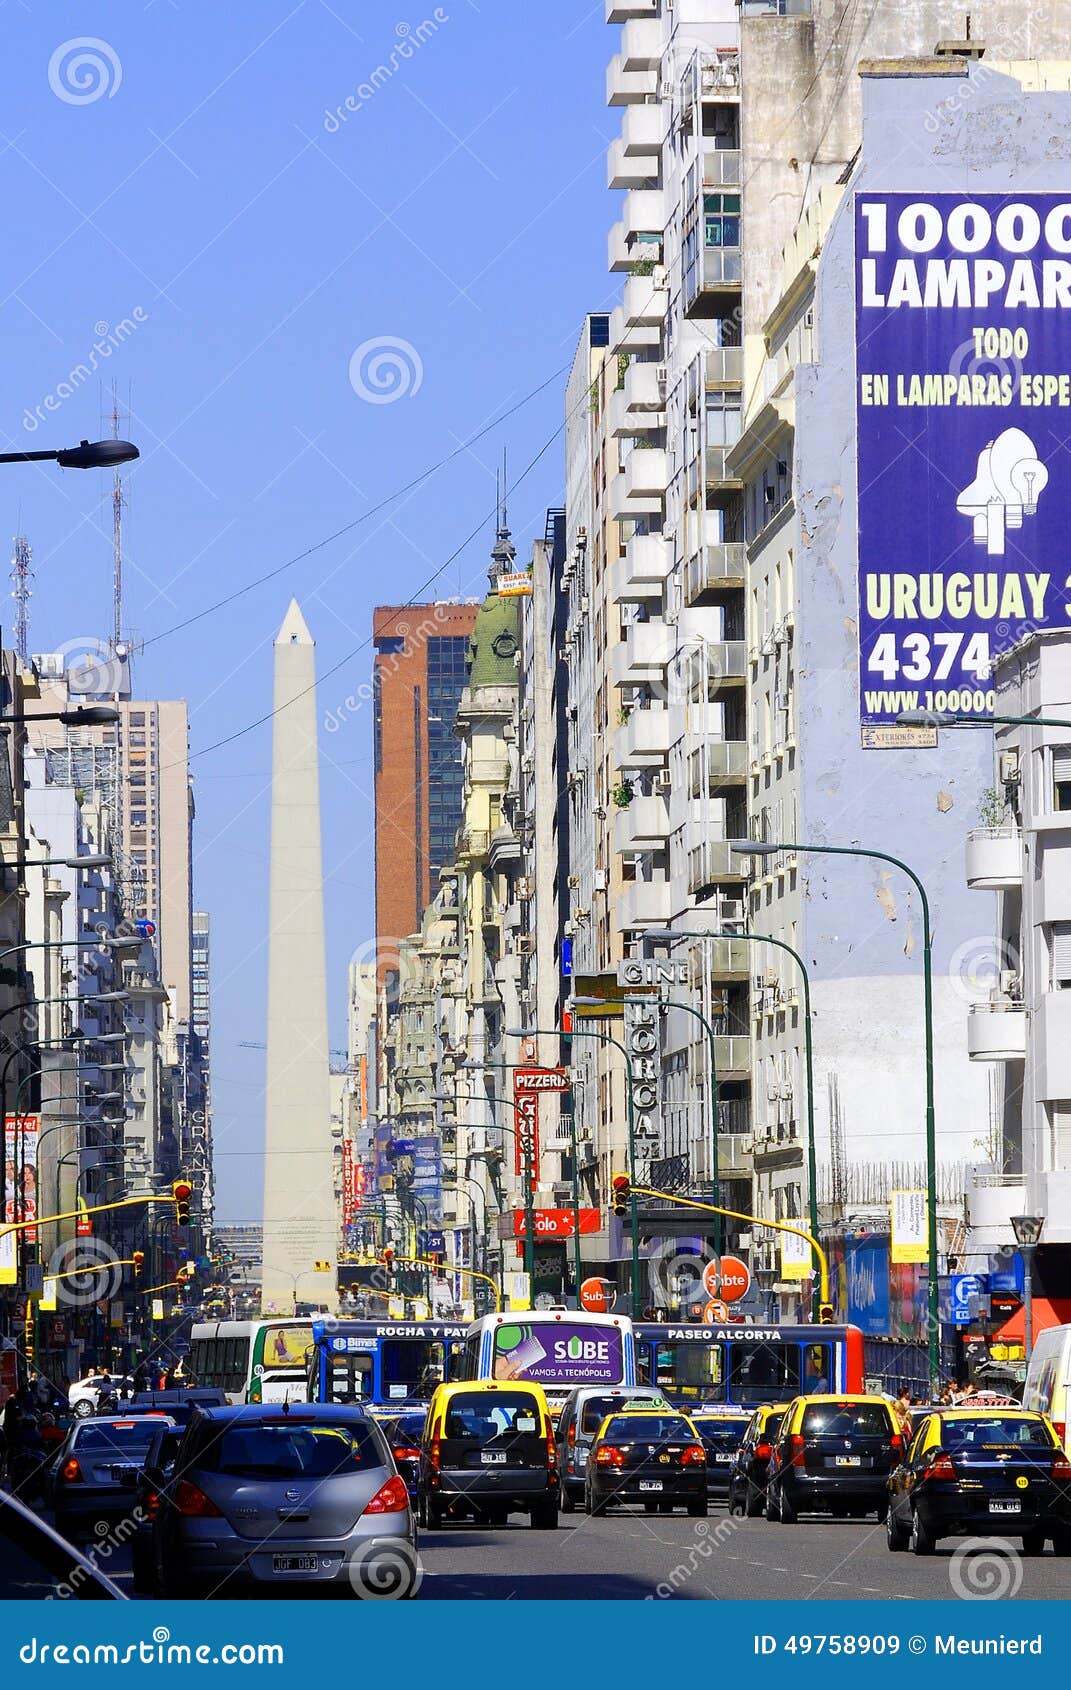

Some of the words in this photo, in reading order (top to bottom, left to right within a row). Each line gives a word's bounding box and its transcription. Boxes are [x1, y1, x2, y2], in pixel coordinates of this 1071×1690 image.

[862, 203, 1071, 253] 10000
[862, 259, 1071, 308] LAMPAR
[973, 327, 1029, 359] TODO
[862, 374, 889, 406] EN
[897, 374, 1012, 406] LAMPARAS
[1020, 374, 1070, 406] ESPE
[866, 573, 1050, 619] URUGUAY
[868, 633, 991, 680] 4374
[623, 962, 688, 984] CINE
[516, 1075, 569, 1088] PIZZERIA
[632, 1002, 659, 1139] LORCA
[708, 1274, 745, 1287] Sbte
[377, 1327, 425, 1337] ROCHA
[430, 1327, 440, 1337] Y
[668, 1330, 713, 1340] PASEO
[717, 1330, 781, 1340] ALCORTA
[554, 1335, 609, 1360] SUBE
[529, 1369, 556, 1377] VAMOS
[557, 1369, 563, 1377] A
[565, 1367, 612, 1378] TECNÓPOLIS
[275, 1558, 293, 1569] JGF
